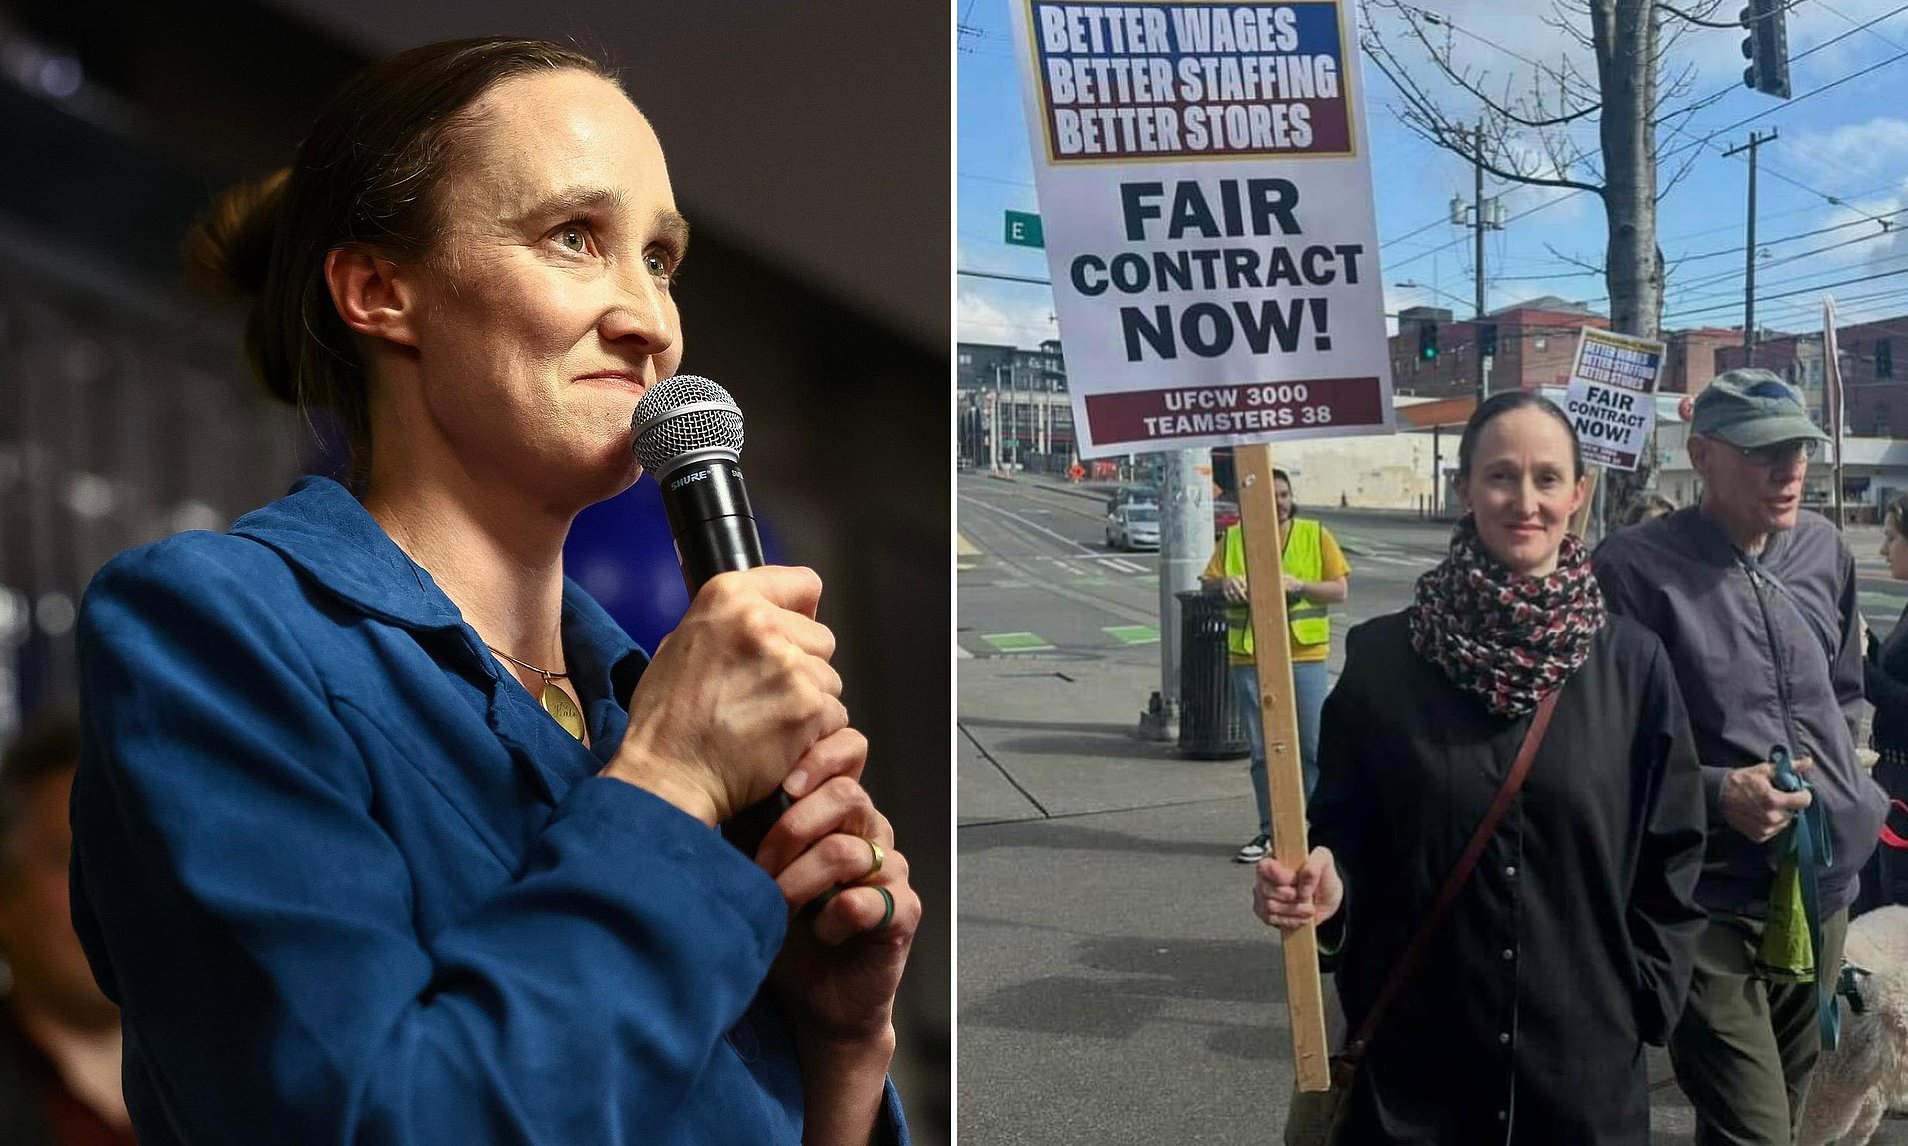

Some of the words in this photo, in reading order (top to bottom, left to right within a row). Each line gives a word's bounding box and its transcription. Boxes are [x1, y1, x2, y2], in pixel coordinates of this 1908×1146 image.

[1039, 5, 1170, 54] BETTER
[1171, 7, 1298, 54] WAGES
[1046, 57, 1176, 104] BETTER
[1179, 54, 1339, 103] STAFFING
[1054, 107, 1181, 155] BETTER
[1184, 103, 1313, 151] STORES
[1120, 178, 1302, 241] FAIR
[1012, 221, 1025, 240] E
[1070, 244, 1363, 296] CONTRACT
[1120, 298, 1333, 362] NOW!
[1164, 388, 1239, 411] UFCW
[1246, 384, 1309, 406] 3000
[1587, 386, 1634, 411] FAIR
[1143, 408, 1294, 436] TEAMSTERS
[1301, 406, 1332, 425] 38
[1568, 401, 1645, 428] CONTRACT
[1575, 418, 1631, 444] NOW!
[671, 470, 707, 491] SHURE
